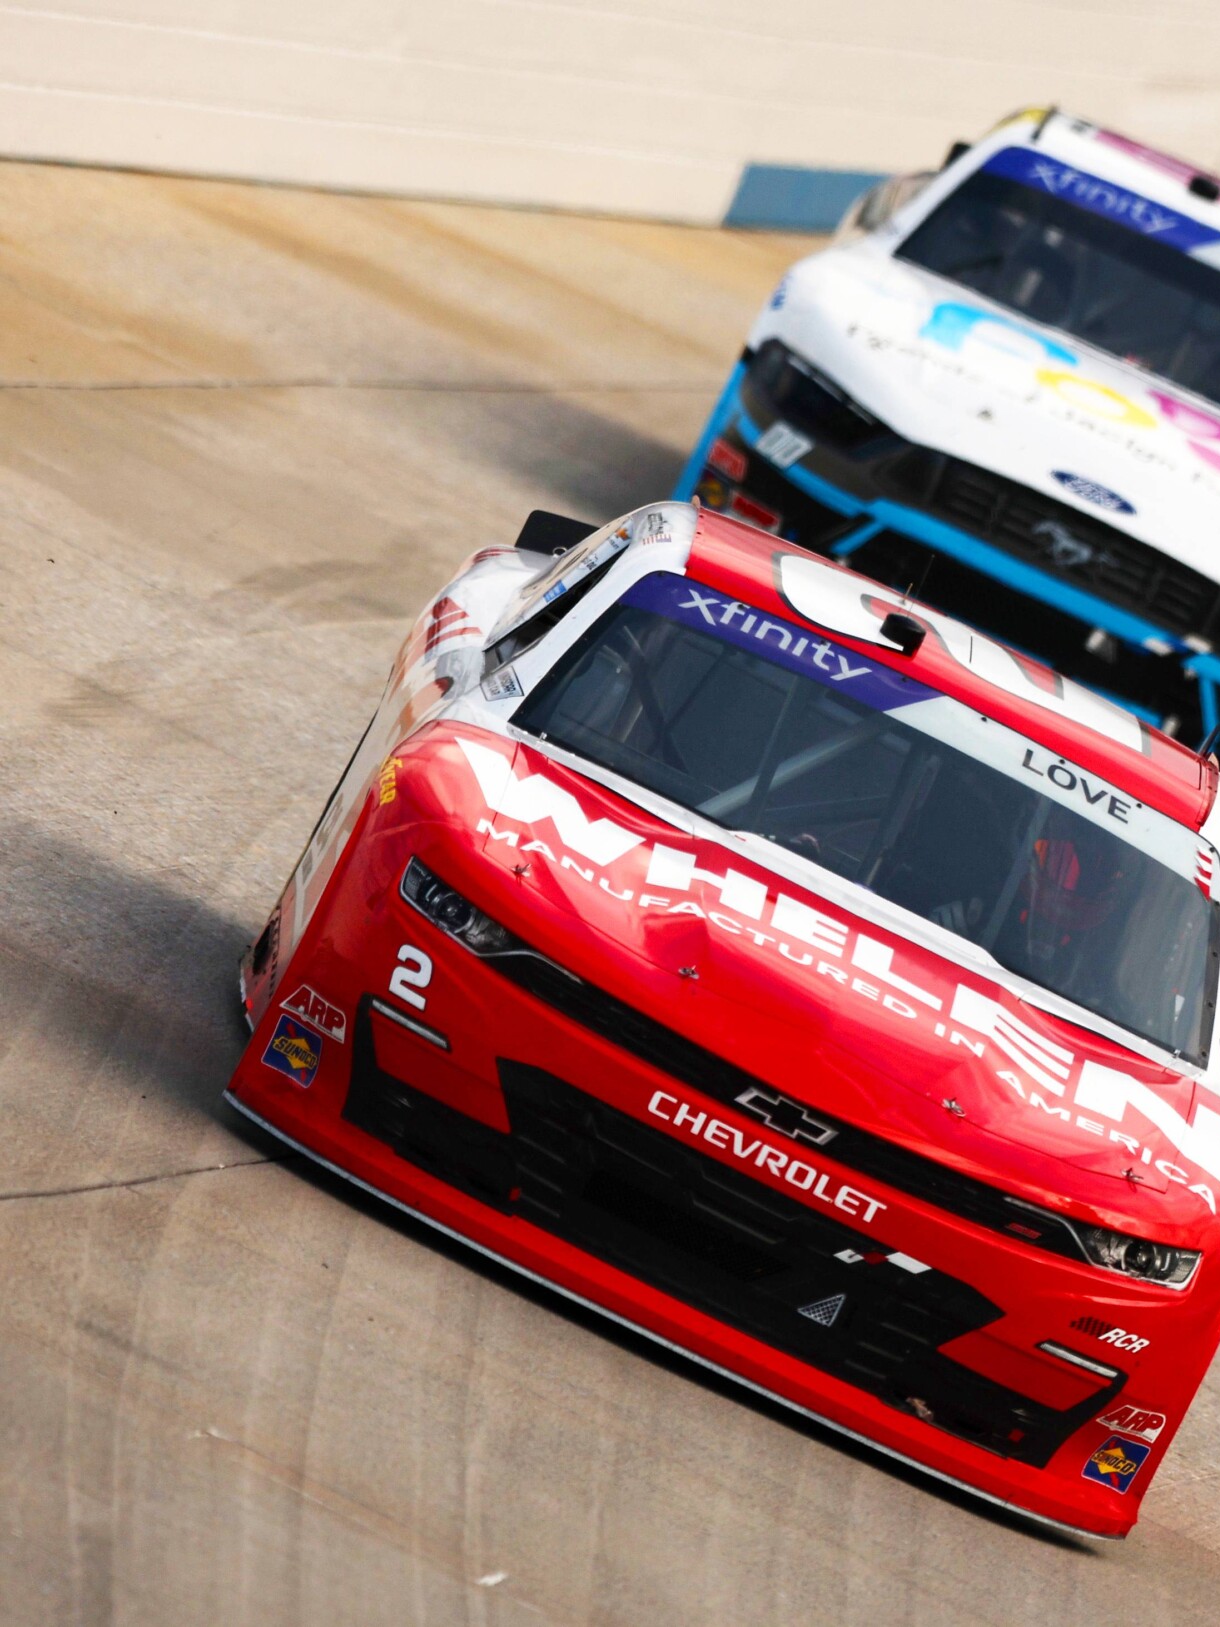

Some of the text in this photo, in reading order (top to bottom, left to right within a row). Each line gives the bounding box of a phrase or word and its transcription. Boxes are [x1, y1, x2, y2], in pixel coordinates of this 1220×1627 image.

[1029, 162, 1177, 235] xfinity
[677, 588, 873, 682] xfinity
[1022, 748, 1132, 825] LOVE
[283, 985, 345, 1038] ARP
[388, 943, 434, 1012] 2
[475, 817, 917, 1021] MANUFACTURED
[933, 1019, 986, 1058] IN
[995, 1069, 1217, 1216] AMERICA
[274, 1036, 318, 1070] SUNOCO
[647, 1089, 888, 1223] CHEVROLET
[1098, 1327, 1150, 1354] RCR
[1102, 1405, 1165, 1435] ARP
[1092, 1450, 1137, 1474] SUNOCO
